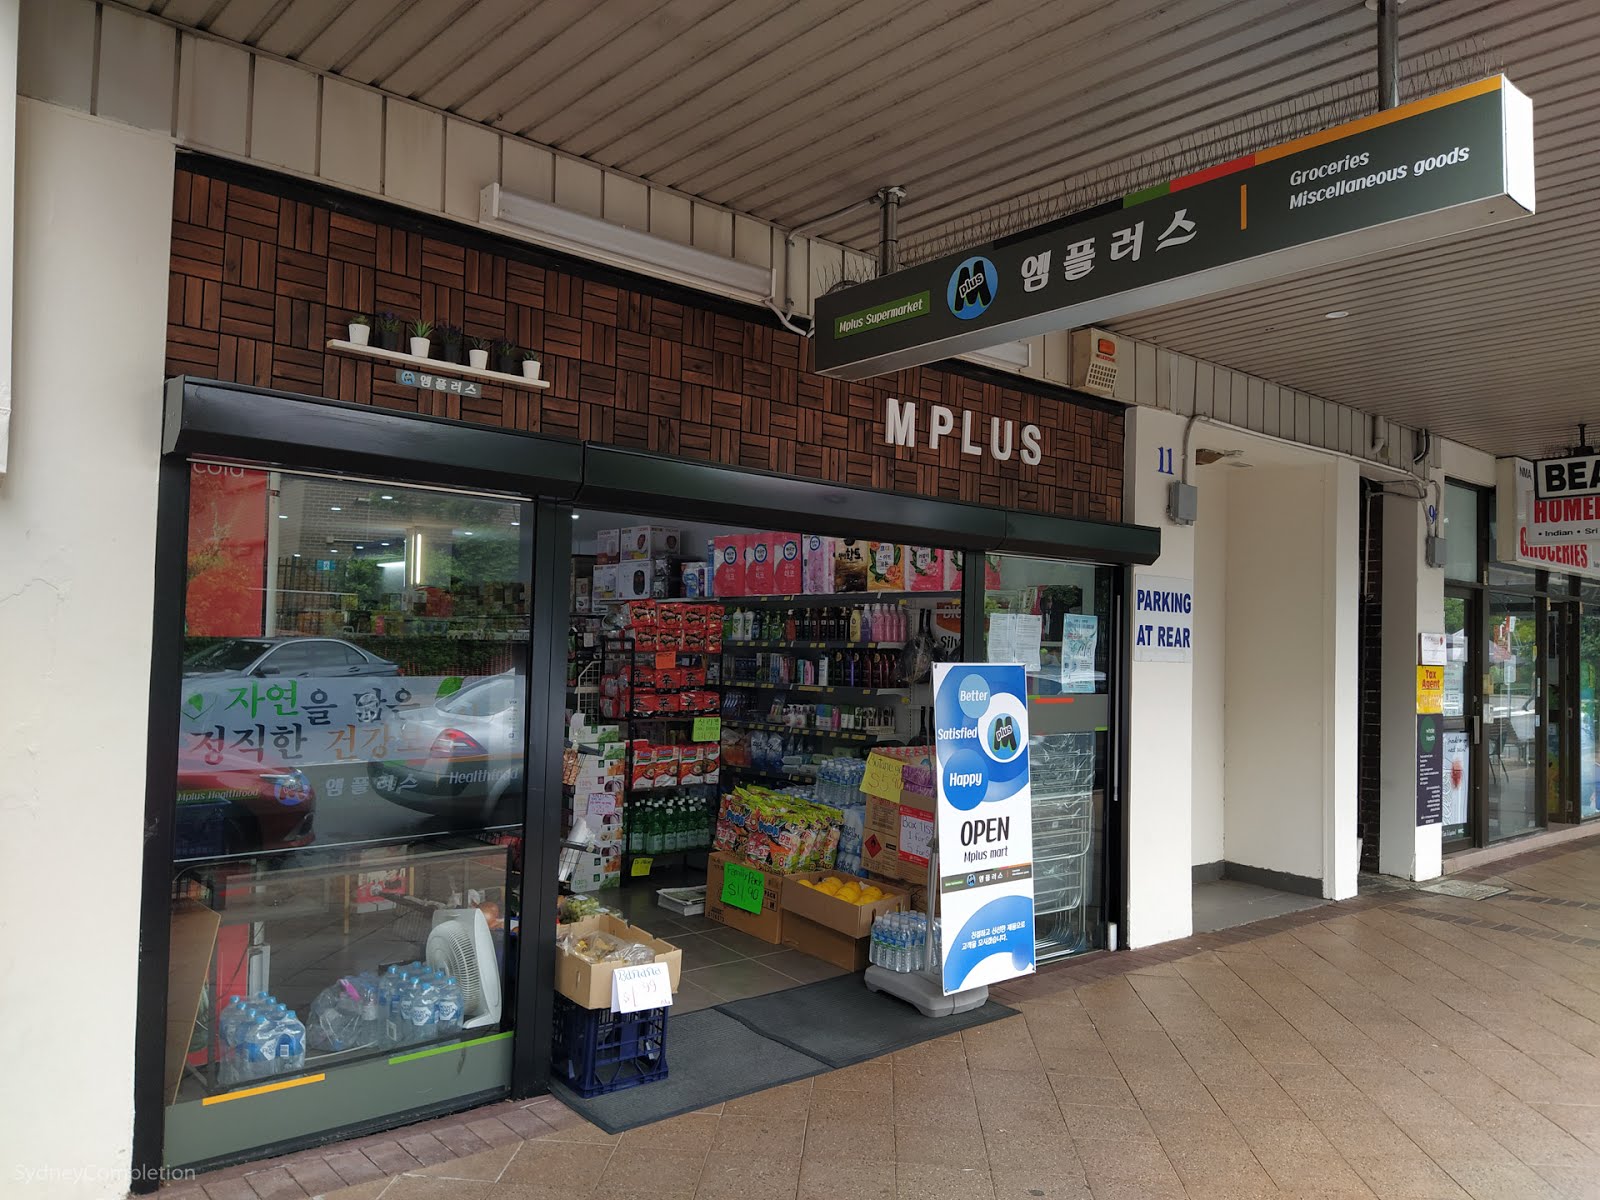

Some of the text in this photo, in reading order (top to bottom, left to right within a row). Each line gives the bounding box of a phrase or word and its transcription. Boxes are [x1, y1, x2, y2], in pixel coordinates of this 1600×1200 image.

[1289, 146, 1470, 210] Miscellaneous goods
[1290, 152, 1370, 186] Groceries
[1021, 208, 1198, 293] 엠플러스
[959, 273, 984, 298] plus
[839, 298, 923, 333] Mplus Supermarket
[419, 374, 477, 396] 엠플러스
[884, 397, 1042, 466] MPLUS
[1157, 446, 1174, 475] 11
[1428, 504, 1435, 524] 9
[1534, 496, 1600, 524] HOME
[1584, 527, 1598, 535] Sri
[1136, 588, 1192, 614] PARKING
[1136, 624, 1191, 648] AT REAR
[1422, 679, 1440, 689] Agent
[1425, 669, 1436, 679] Tax
[225, 679, 338, 726] 자연을
[960, 690, 988, 702] Better
[190, 723, 308, 766] 정직한
[938, 726, 978, 740] Satisfied
[996, 725, 1012, 741] plus
[949, 772, 982, 788] Happy
[960, 816, 1010, 847] OPEN
[963, 845, 1009, 863] Mplus mart
